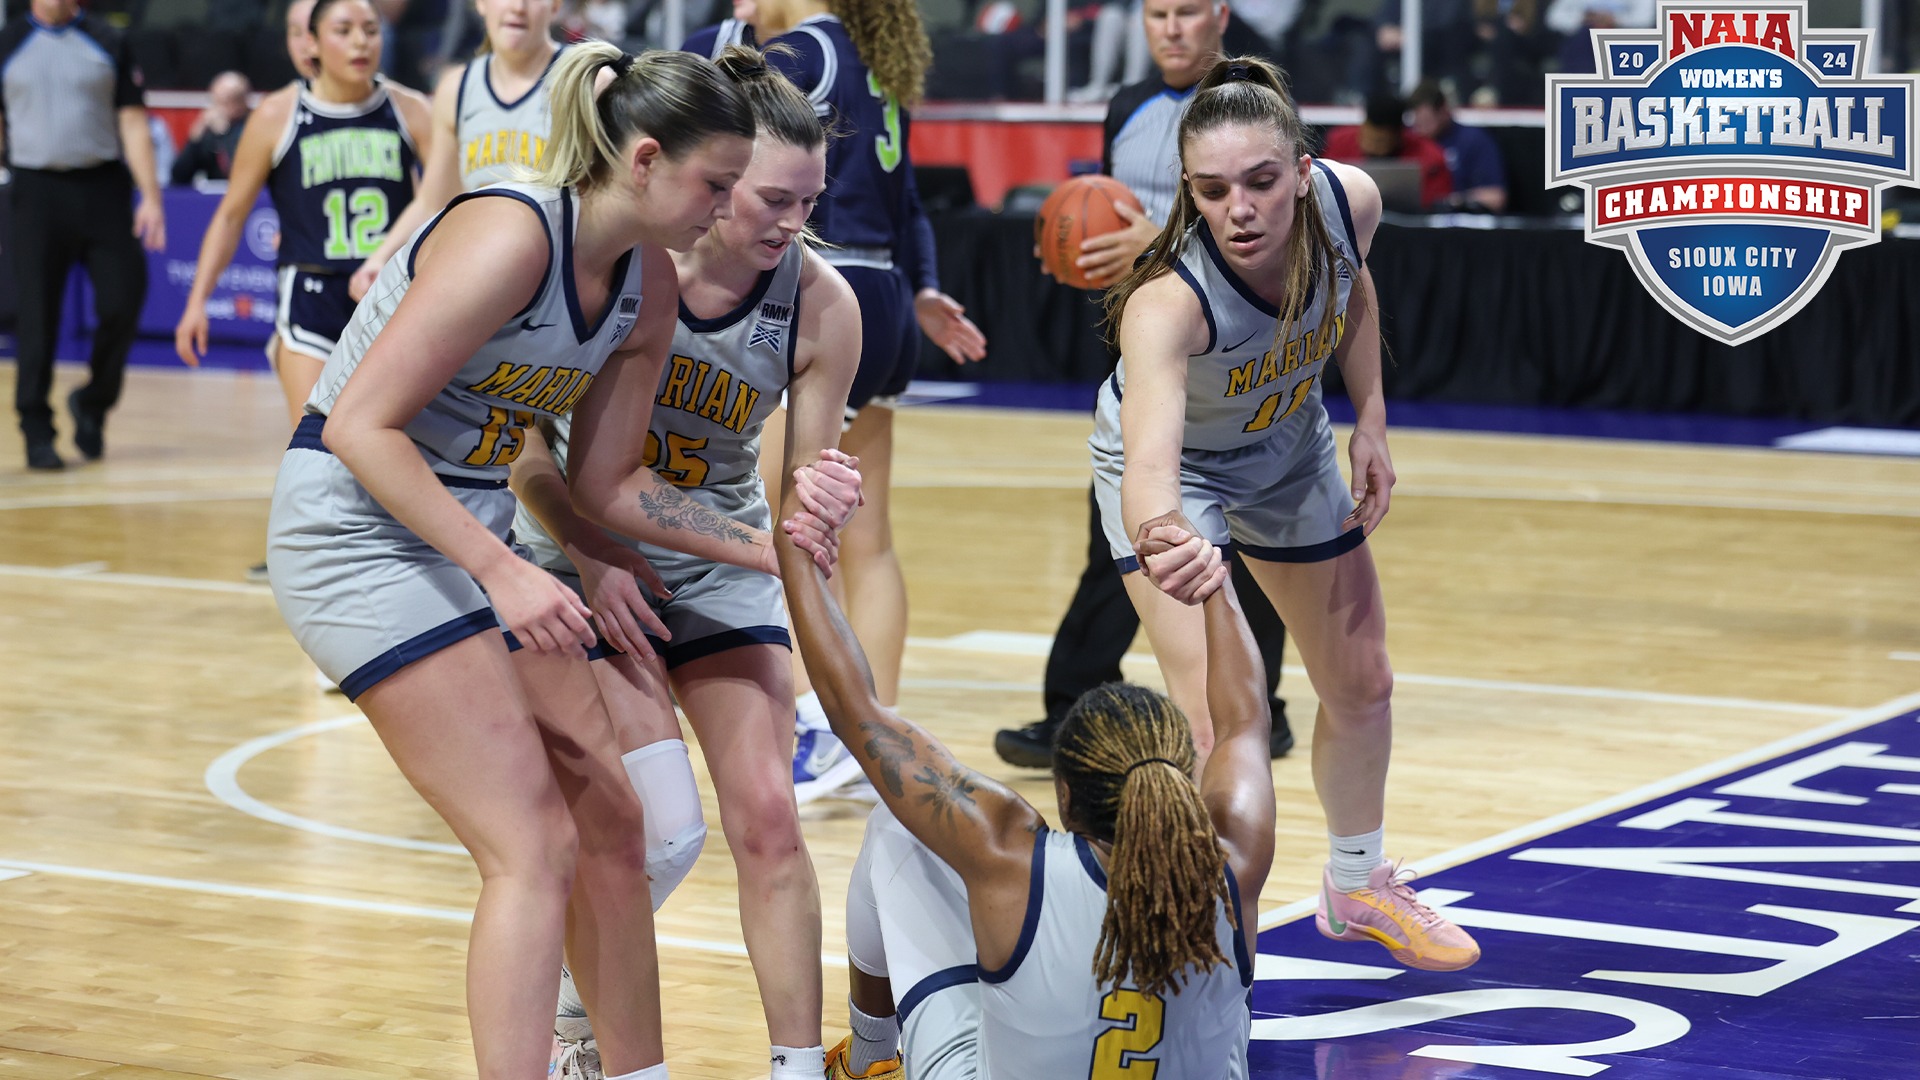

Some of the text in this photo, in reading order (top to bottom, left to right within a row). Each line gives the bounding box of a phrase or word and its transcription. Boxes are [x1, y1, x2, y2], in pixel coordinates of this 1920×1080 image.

[323, 187, 389, 260] 12
[761, 302, 791, 323] RMK
[466, 361, 595, 416] MARIA
[654, 353, 761, 435] RIAN
[1241, 373, 1317, 433] 11
[1087, 986, 1167, 1080] 2
